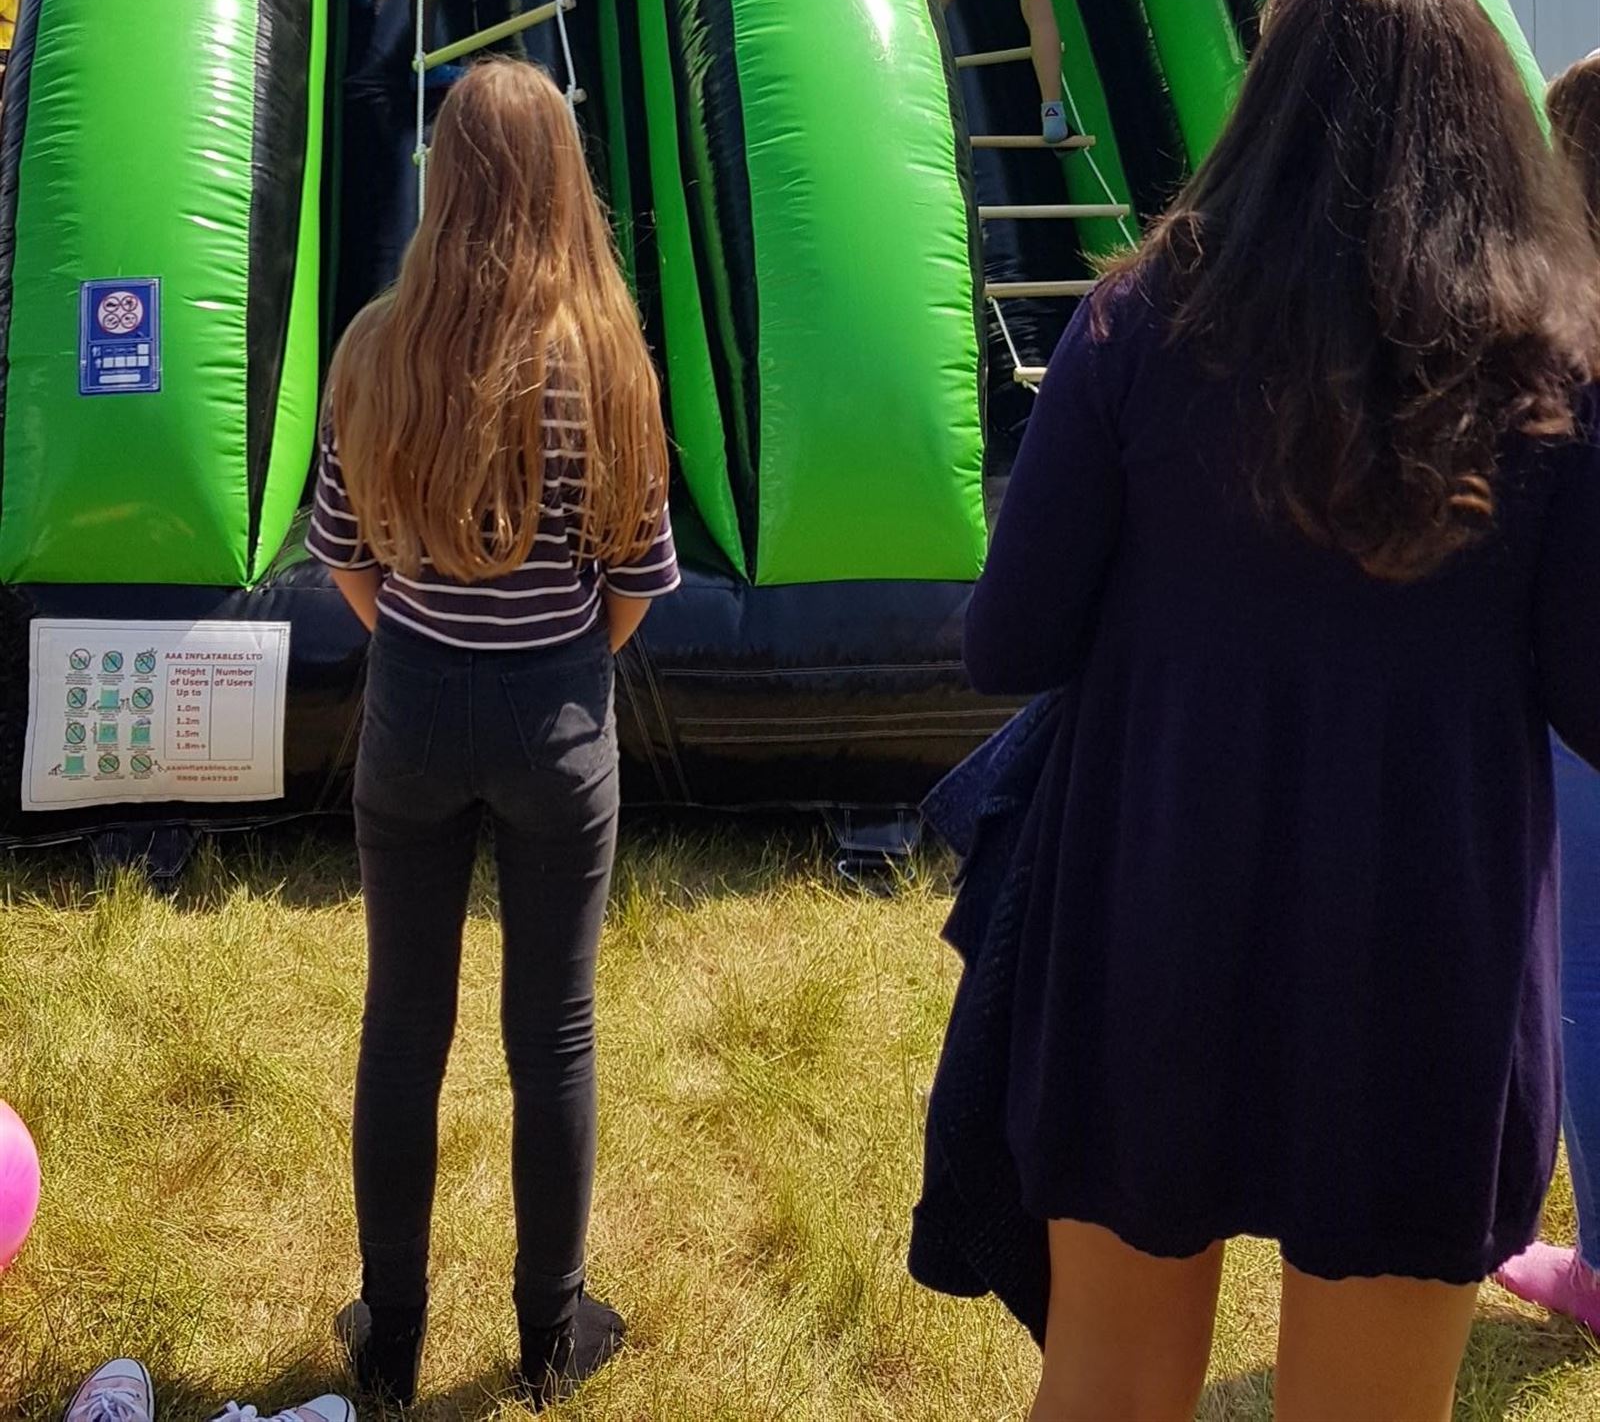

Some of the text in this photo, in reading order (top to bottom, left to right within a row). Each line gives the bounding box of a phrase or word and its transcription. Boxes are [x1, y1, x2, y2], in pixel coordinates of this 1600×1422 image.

[185, 652, 243, 660] INFLATABLES
[246, 653, 263, 661] LTD
[175, 668, 206, 677] Height
[215, 668, 253, 676] Number
[170, 678, 209, 686] of Users
[227, 679, 253, 687] Users
[176, 689, 189, 698] Up
[176, 730, 199, 738] 1.5m
